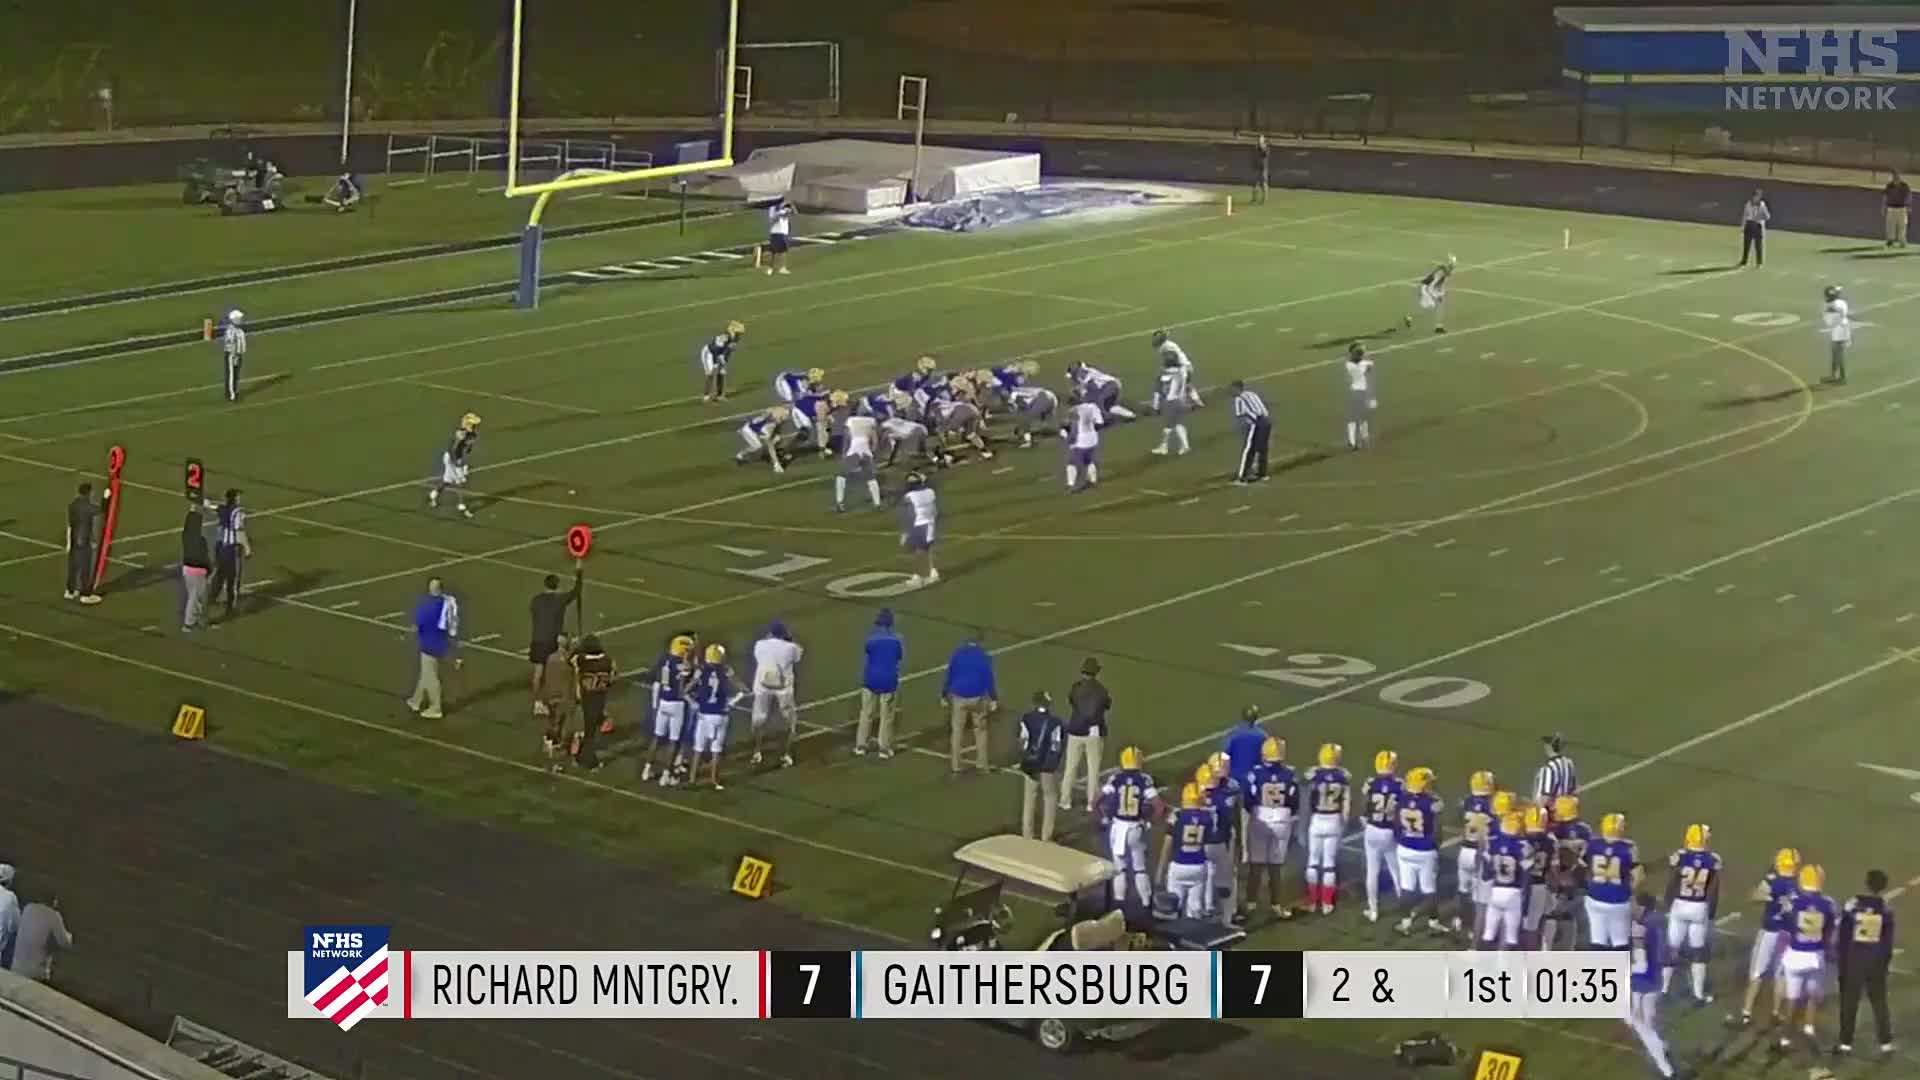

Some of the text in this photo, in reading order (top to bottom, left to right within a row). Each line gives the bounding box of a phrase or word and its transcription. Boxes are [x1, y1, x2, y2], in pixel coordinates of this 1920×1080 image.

[188, 463, 201, 488] 2
[726, 551, 938, 598] 10
[1243, 652, 1491, 708] 20
[180, 710, 199, 734] 10
[738, 863, 764, 891] 20
